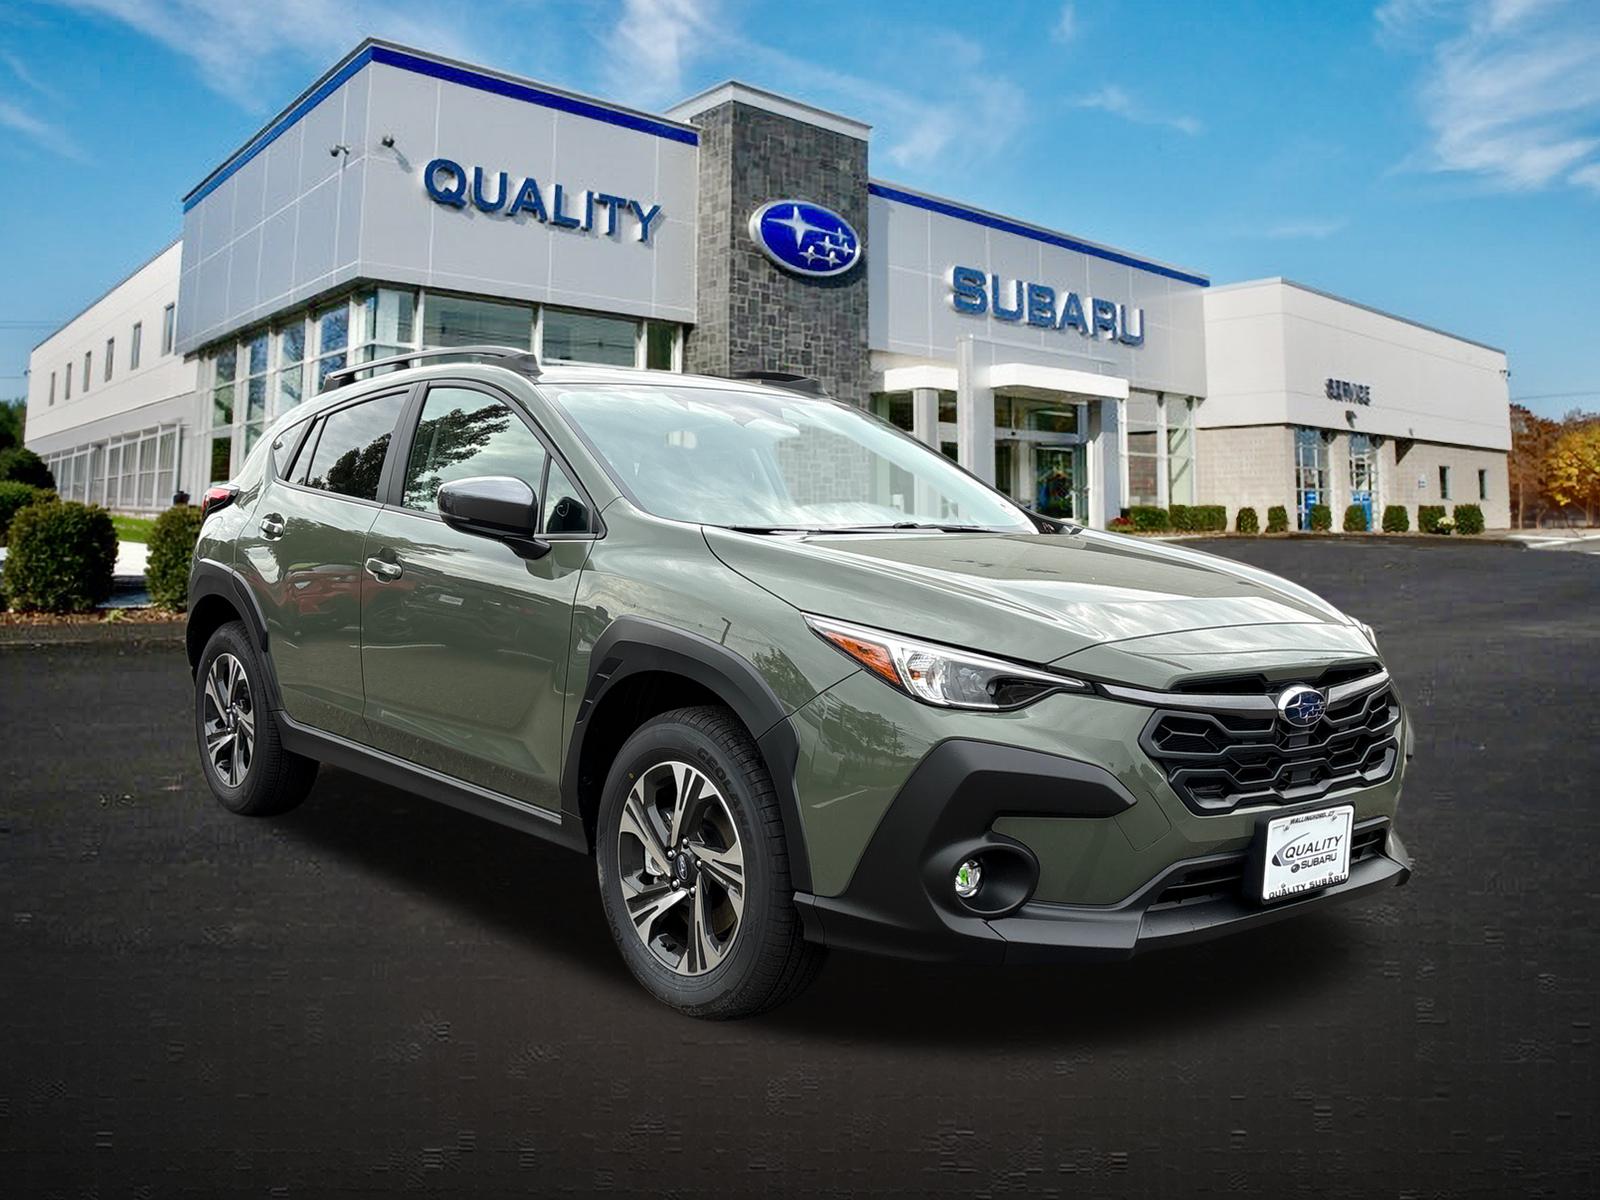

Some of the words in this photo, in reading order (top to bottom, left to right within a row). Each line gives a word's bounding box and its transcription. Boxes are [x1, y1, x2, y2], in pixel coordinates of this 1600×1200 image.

[423, 158, 662, 243] QUALITY
[951, 265, 1146, 347] SUBARU
[1285, 835, 1343, 858] QUALITY
[1302, 853, 1337, 869] SUBARU
[1269, 884, 1306, 899] QUALITY
[1309, 874, 1347, 889] SUBARU
